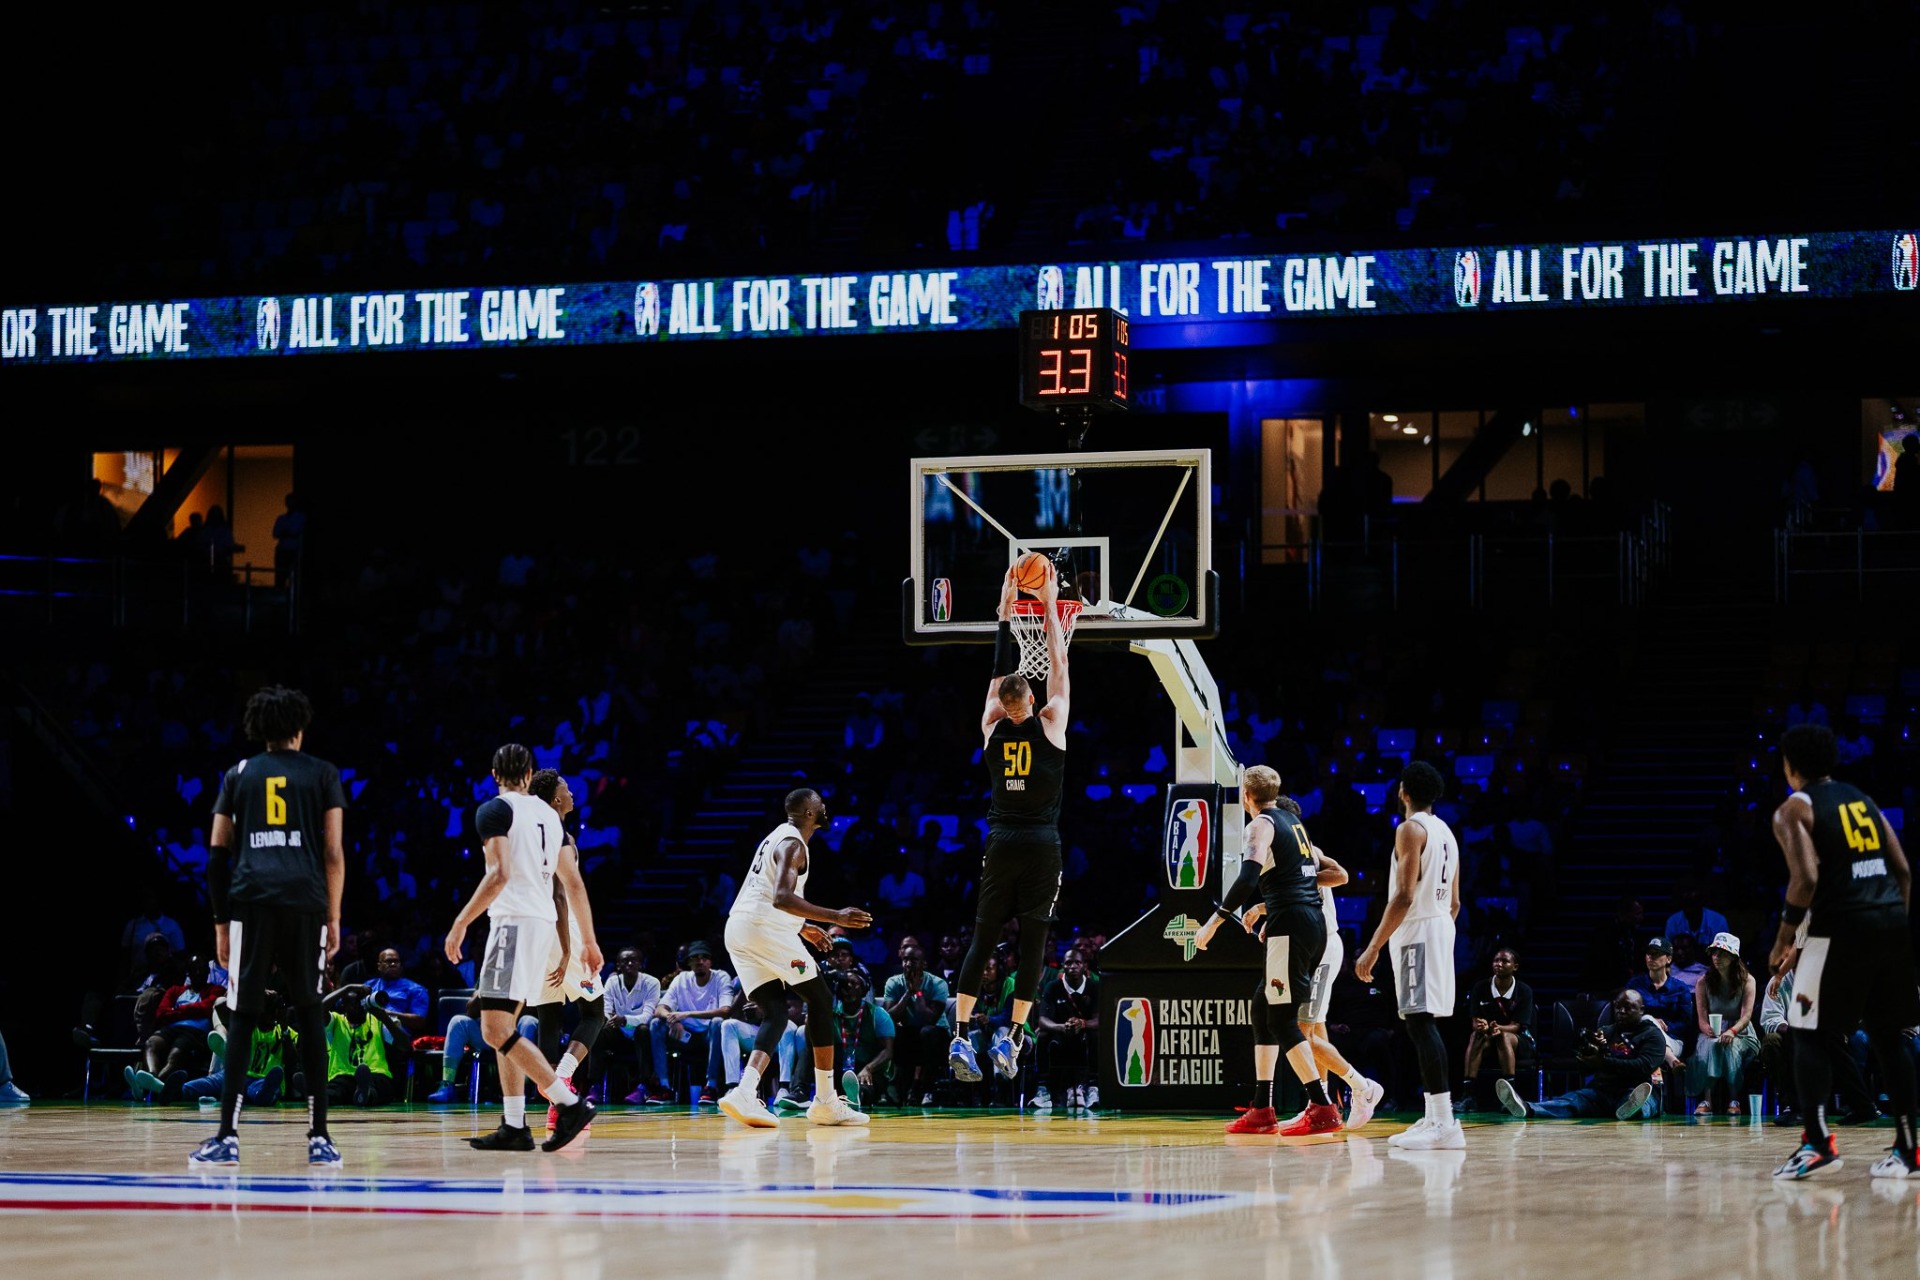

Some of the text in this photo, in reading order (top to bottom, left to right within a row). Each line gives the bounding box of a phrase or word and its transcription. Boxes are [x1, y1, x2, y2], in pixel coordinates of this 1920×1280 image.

[1073, 255, 1377, 317] ALL FOR THE GAME
[1492, 238, 1809, 304] ALL FOR THE GAME
[47, 306, 99, 357] THE
[109, 302, 190, 355] GAME
[289, 287, 565, 349] ALL FOR THE GAME
[668, 272, 958, 335] ALL FOR THE GAME
[560, 426, 641, 466] 122
[1003, 741, 1032, 777] 50
[1005, 779, 1026, 791] CRAIG
[266, 776, 287, 825] 6
[1838, 800, 1881, 853] 45
[537, 823, 549, 866] 1
[1171, 820, 1180, 864] BAL
[493, 926, 509, 991] BAL
[1408, 947, 1418, 1007] BAL
[1308, 965, 1322, 1018] BAL
[1159, 1028, 1221, 1056] AFRICA
[1159, 1058, 1224, 1086] LEAGUE
